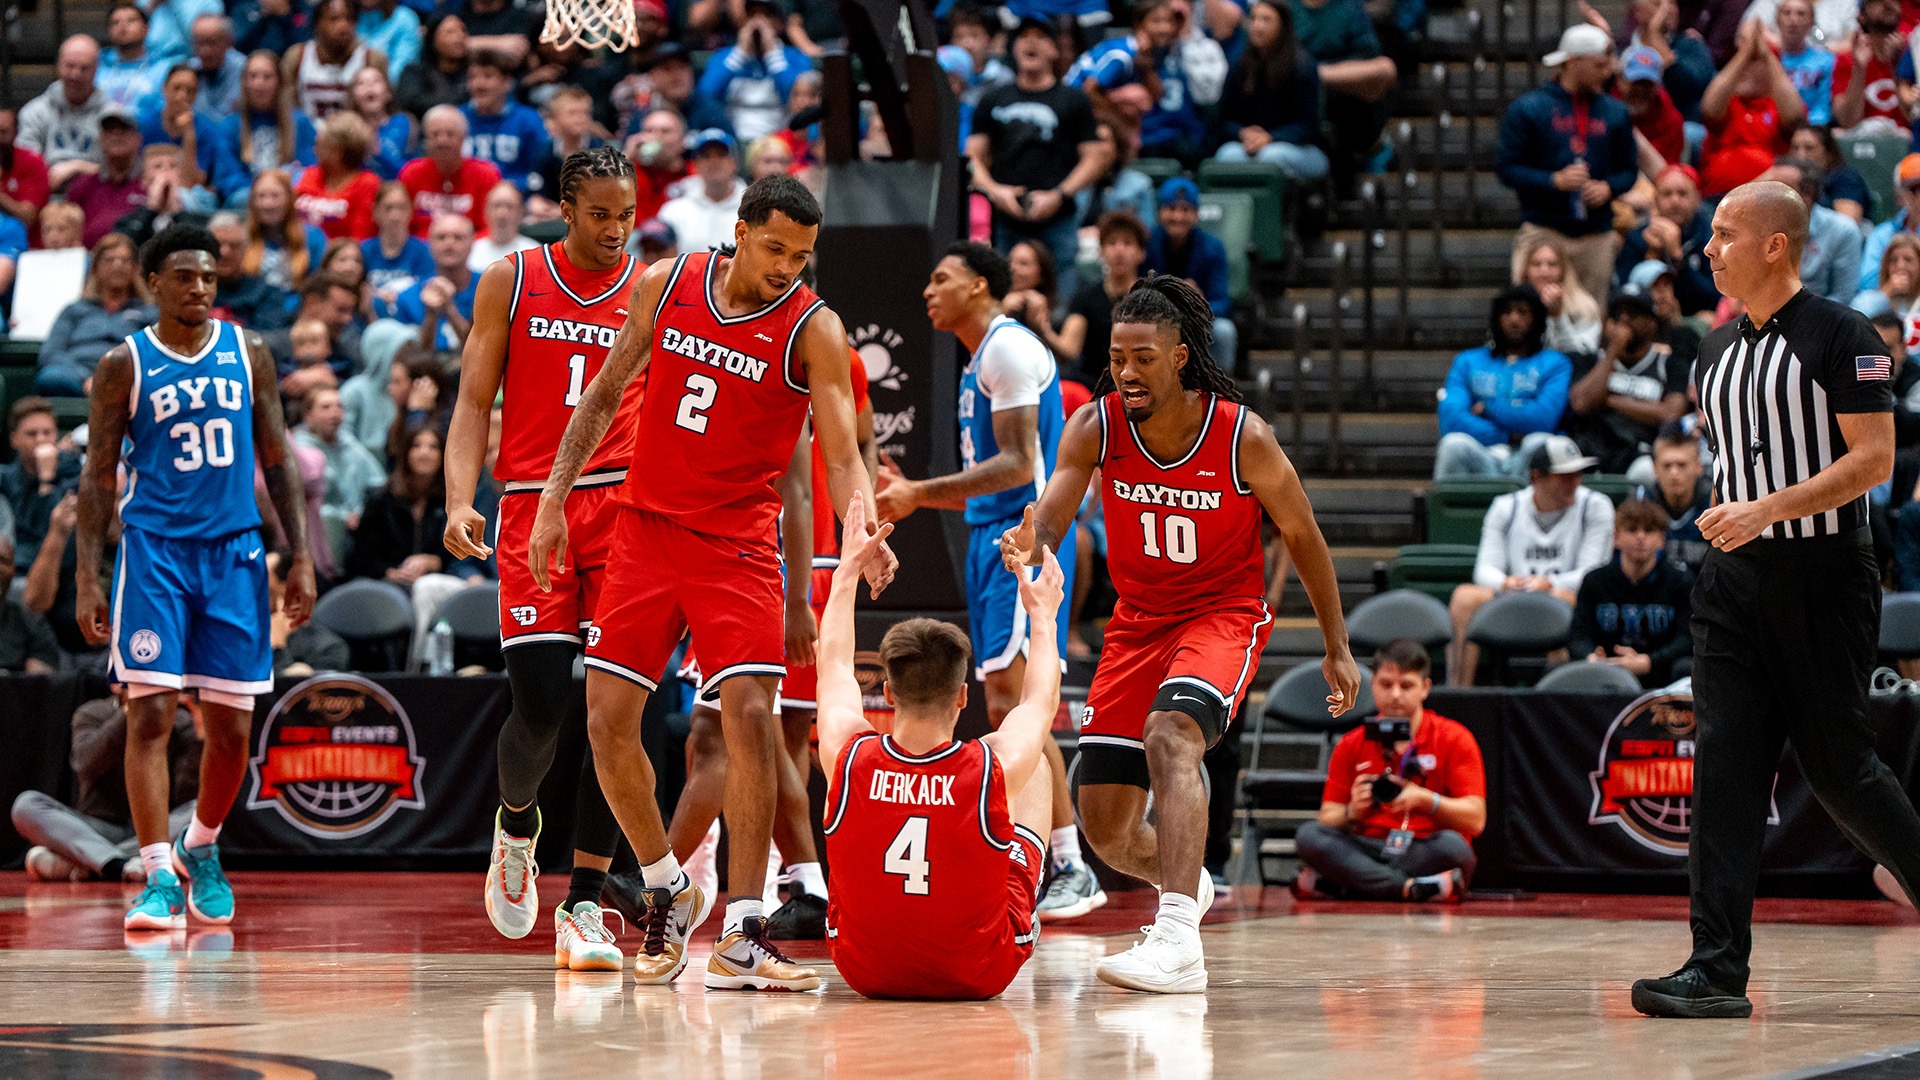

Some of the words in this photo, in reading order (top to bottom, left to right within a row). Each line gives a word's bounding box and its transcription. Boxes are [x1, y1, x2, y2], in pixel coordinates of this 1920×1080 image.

[528, 315, 620, 349] DAYTO
[661, 326, 769, 383] DAYTON
[149, 376, 243, 424] BYU
[565, 353, 586, 407] 1
[675, 373, 718, 434] 2
[169, 417, 235, 472] 30
[1112, 479, 1222, 511] DAYTON
[1140, 511, 1198, 564] 10
[331, 726, 399, 743] EVENTS
[869, 769, 956, 806] DERKACK
[883, 815, 930, 896] 4
